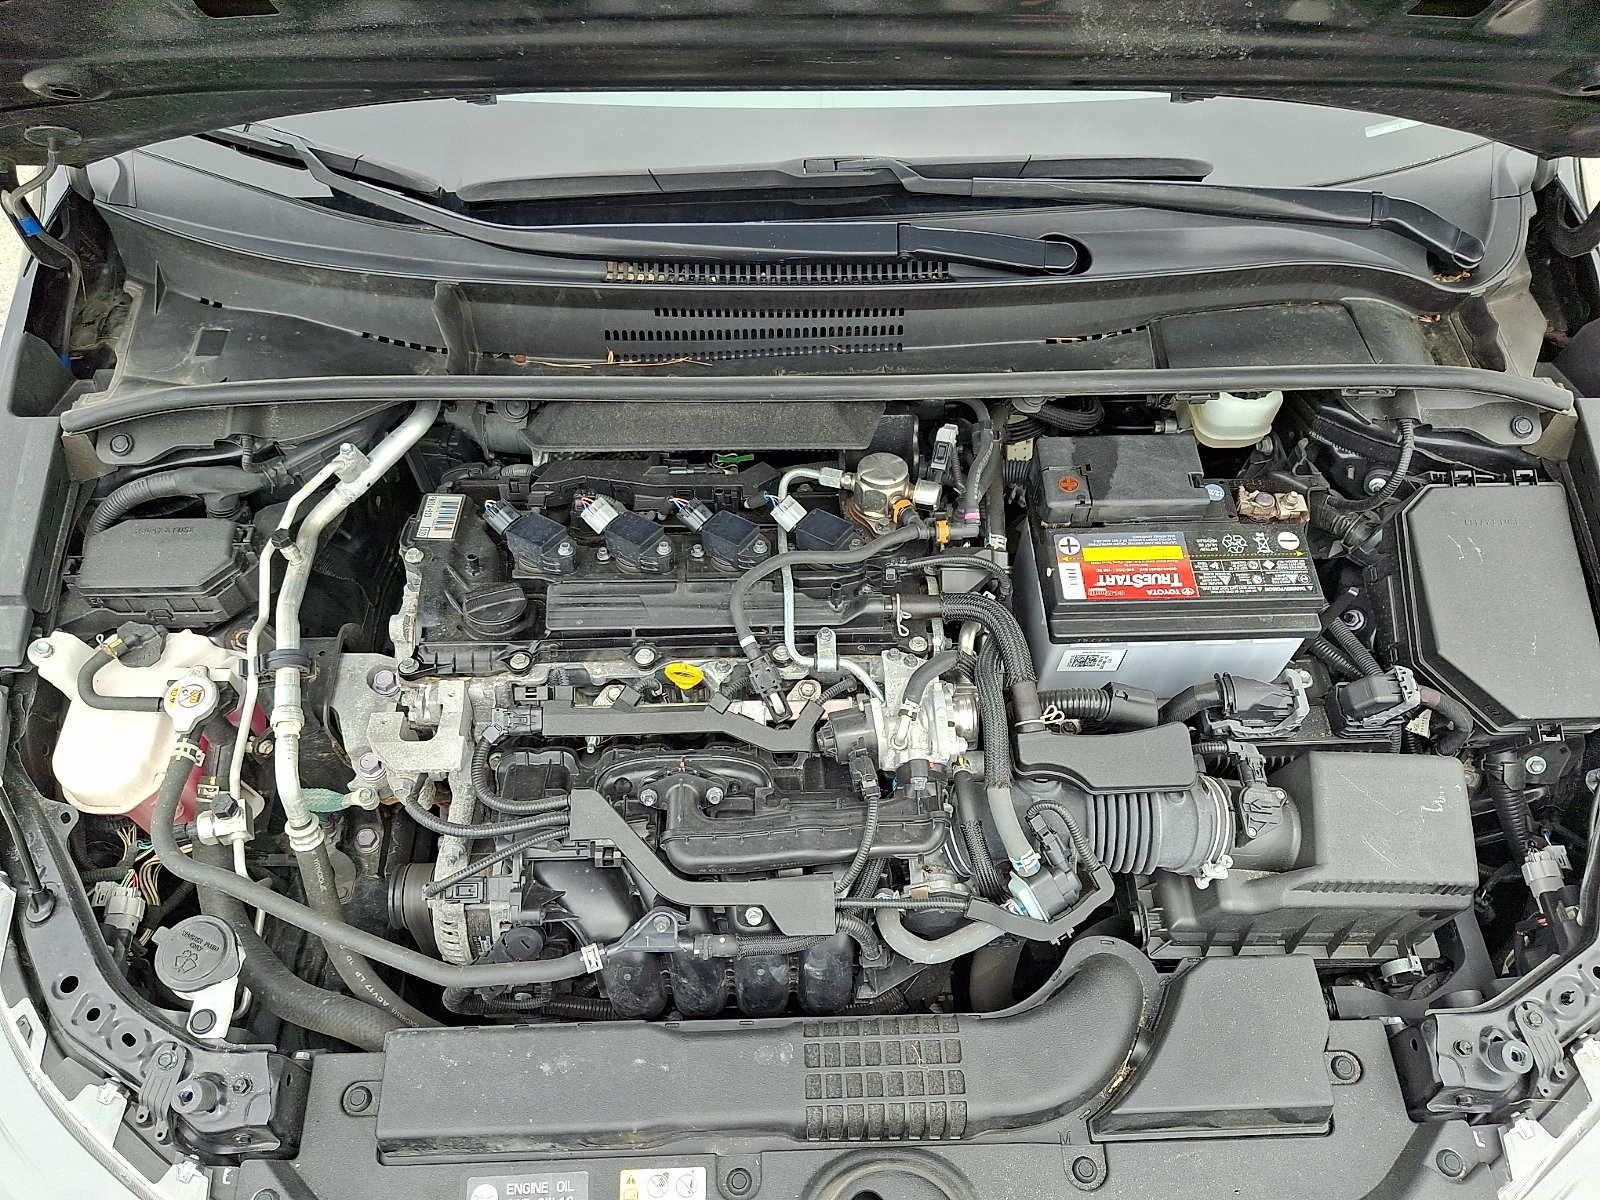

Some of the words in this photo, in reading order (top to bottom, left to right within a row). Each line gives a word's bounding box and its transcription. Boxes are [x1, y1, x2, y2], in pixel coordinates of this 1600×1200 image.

[355, 971, 366, 983] LP
[364, 984, 390, 1007] ACV17
[507, 1182, 548, 1195] ENGINE
[556, 1180, 575, 1193] OIL
